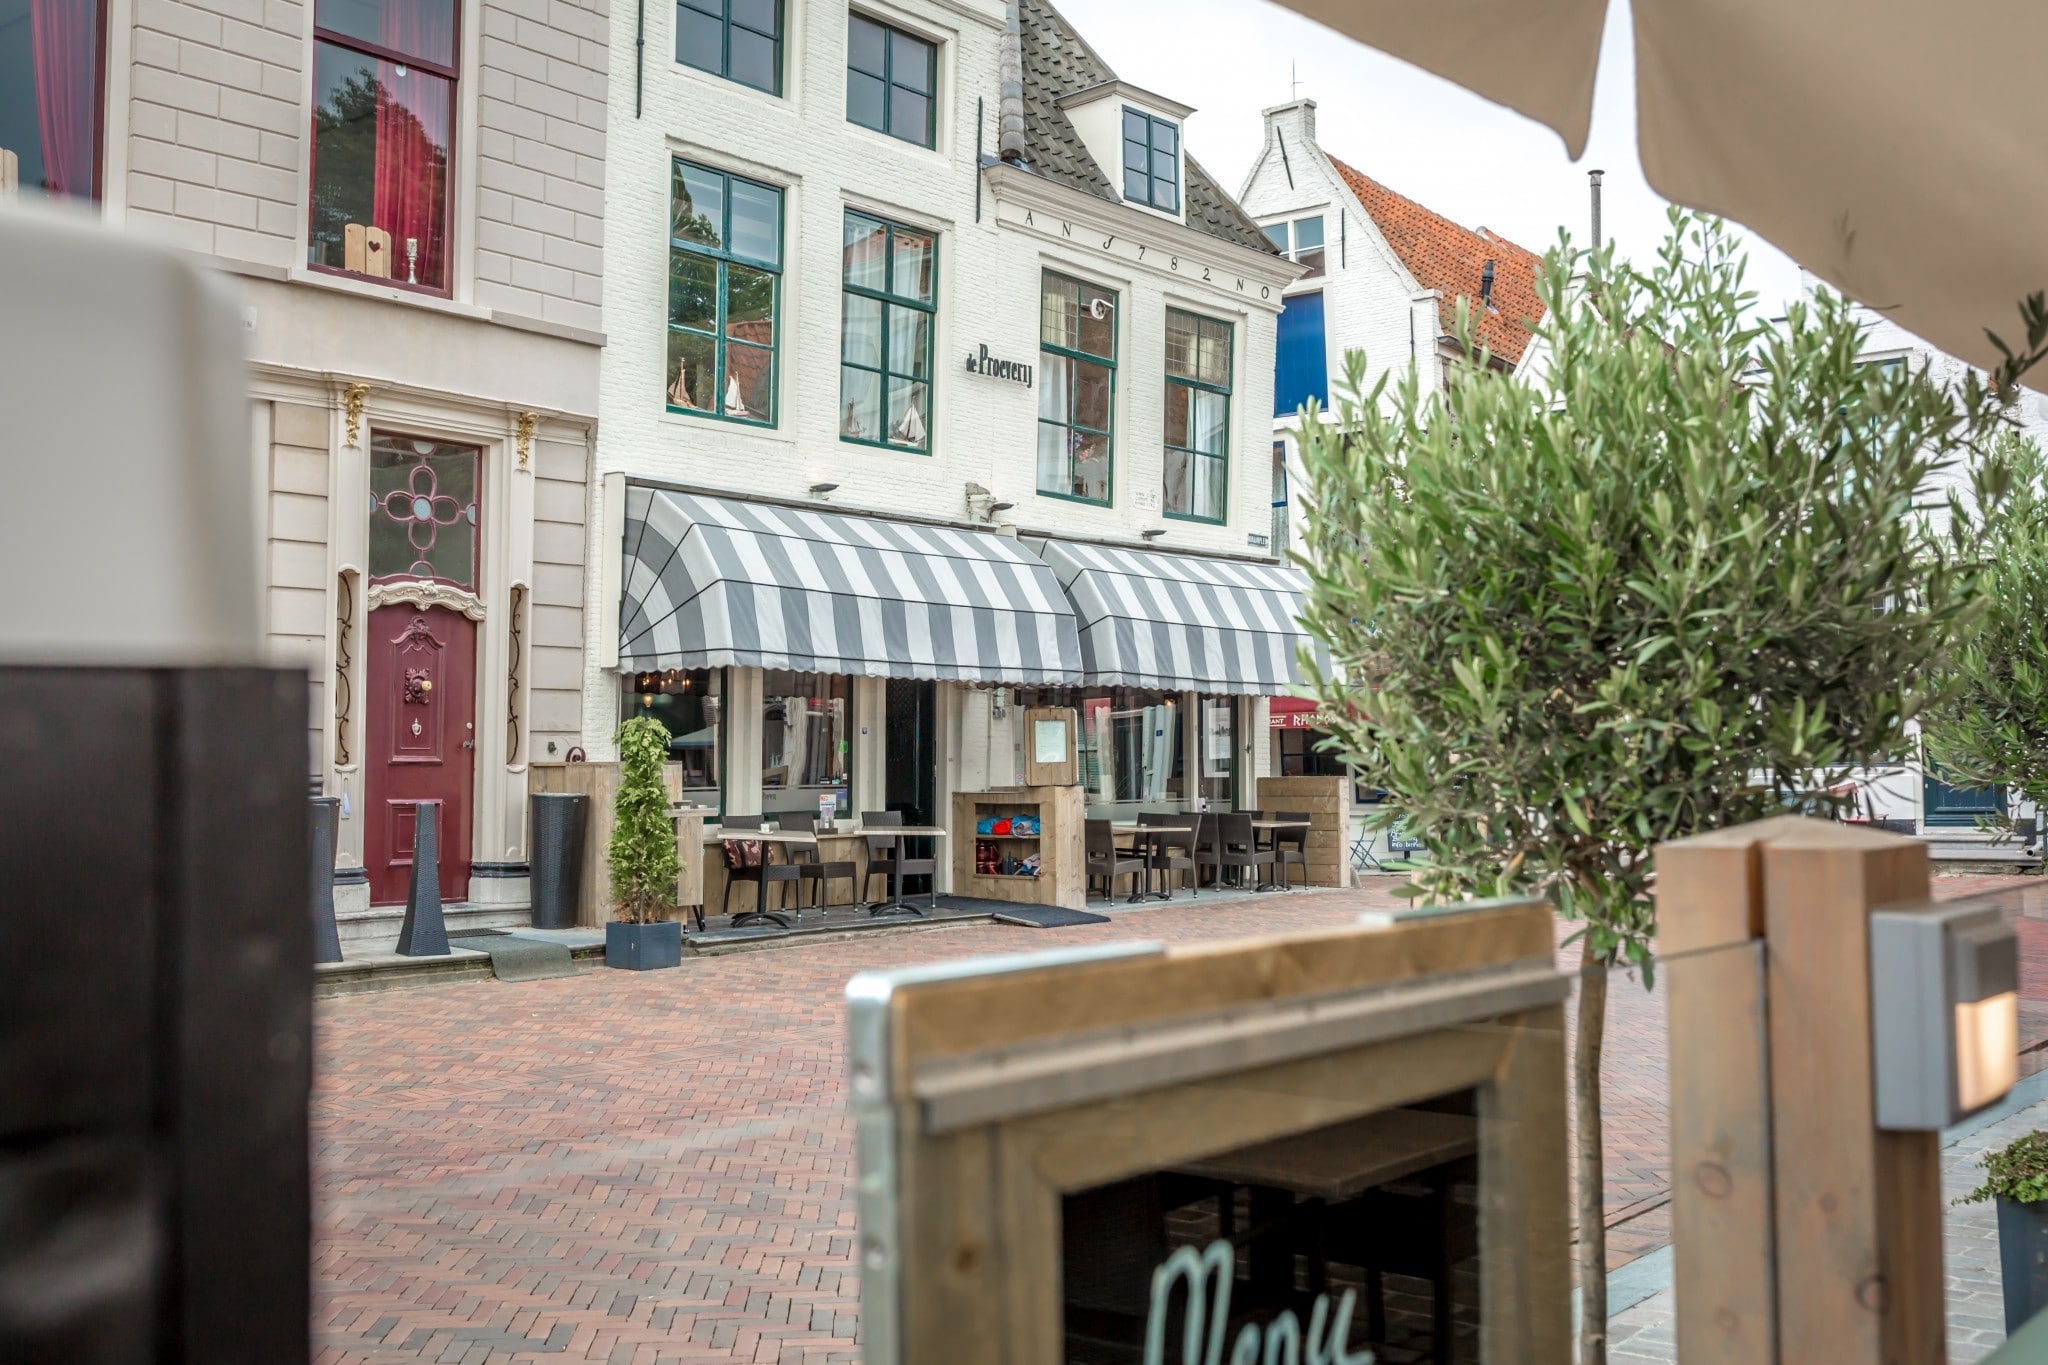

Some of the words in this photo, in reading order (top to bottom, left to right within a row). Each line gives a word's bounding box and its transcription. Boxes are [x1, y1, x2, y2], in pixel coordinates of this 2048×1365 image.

[966, 352, 977, 373] de
[978, 343, 1032, 389] Proeverij
[1142, 1238, 1376, 1365] Menu
